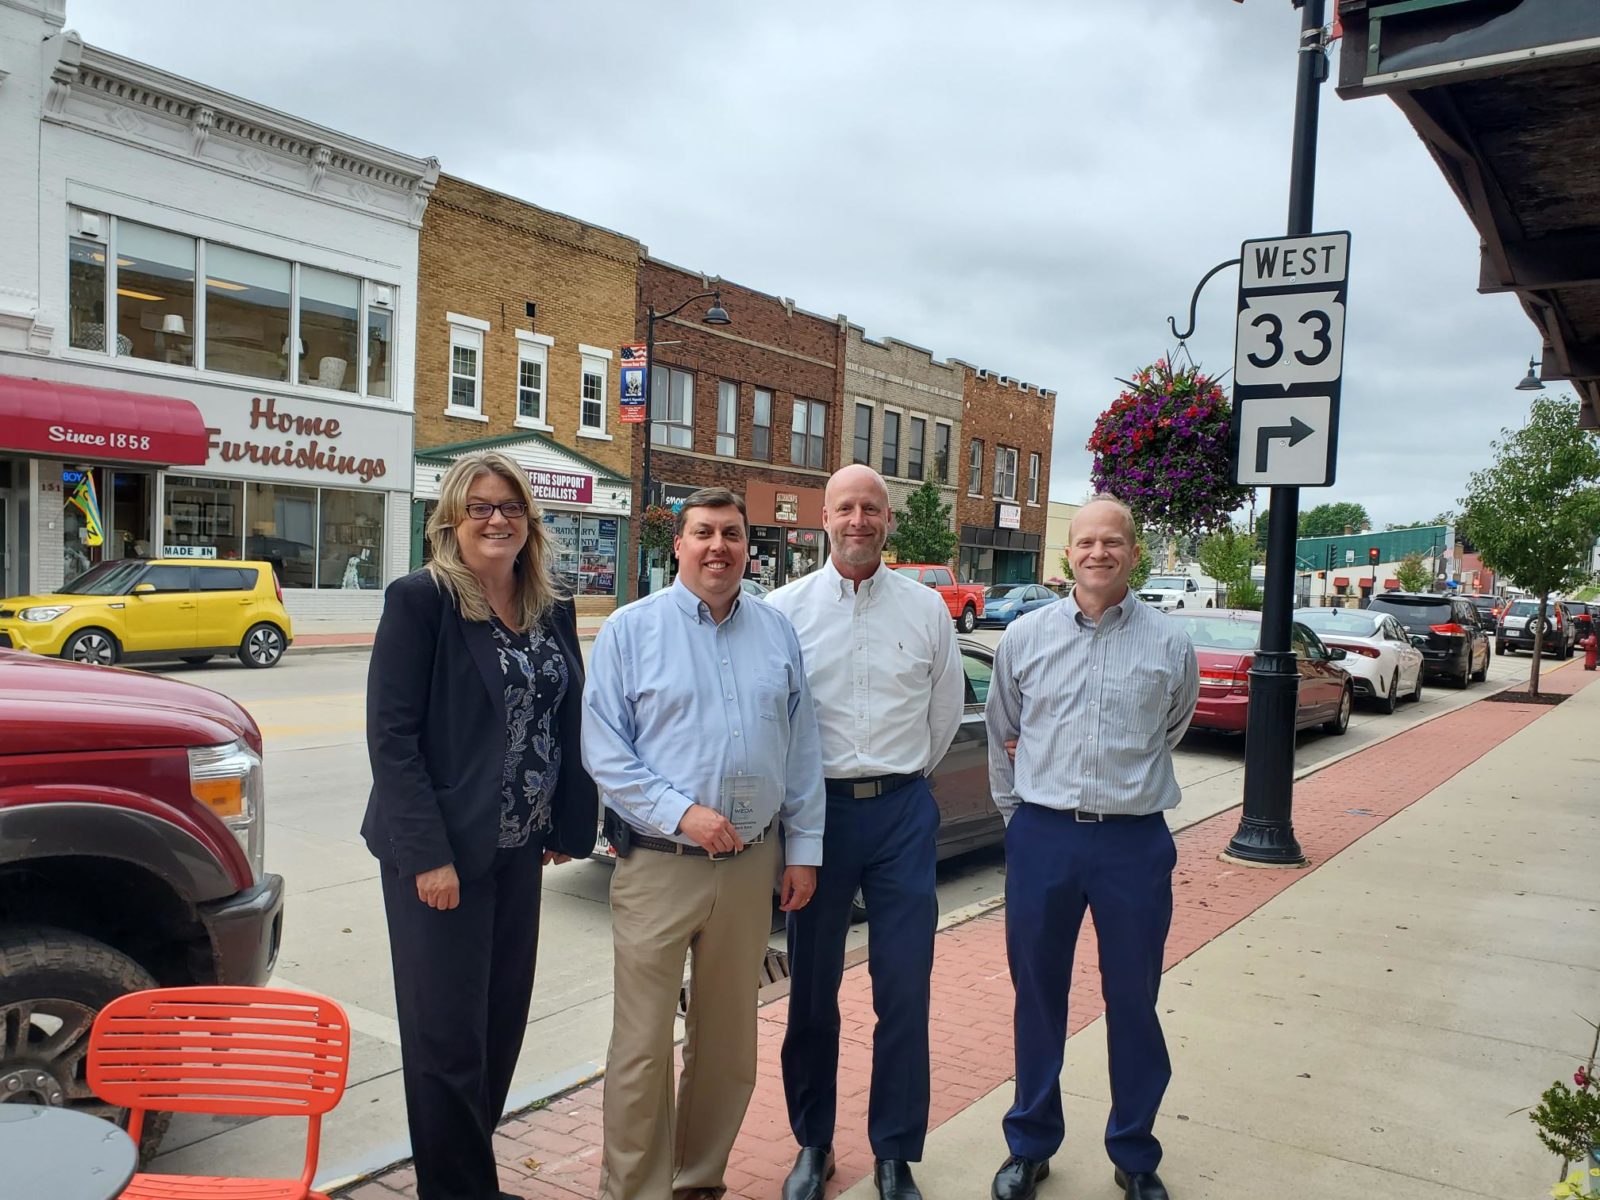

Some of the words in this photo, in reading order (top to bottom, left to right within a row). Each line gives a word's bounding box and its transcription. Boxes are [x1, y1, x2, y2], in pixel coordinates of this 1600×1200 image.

[1255, 245, 1336, 279] WEST
[1247, 310, 1332, 368] 33
[250, 397, 342, 438] Home
[48, 425, 106, 446] Since
[109, 432, 151, 451] 1858
[205, 427, 386, 483] Furnishings
[526, 471, 551, 486] FFING
[552, 474, 585, 489] SUPPORT
[665, 495, 687, 505] SMOK
[164, 546, 194, 556] MADE
[201, 547, 213, 556] IN
